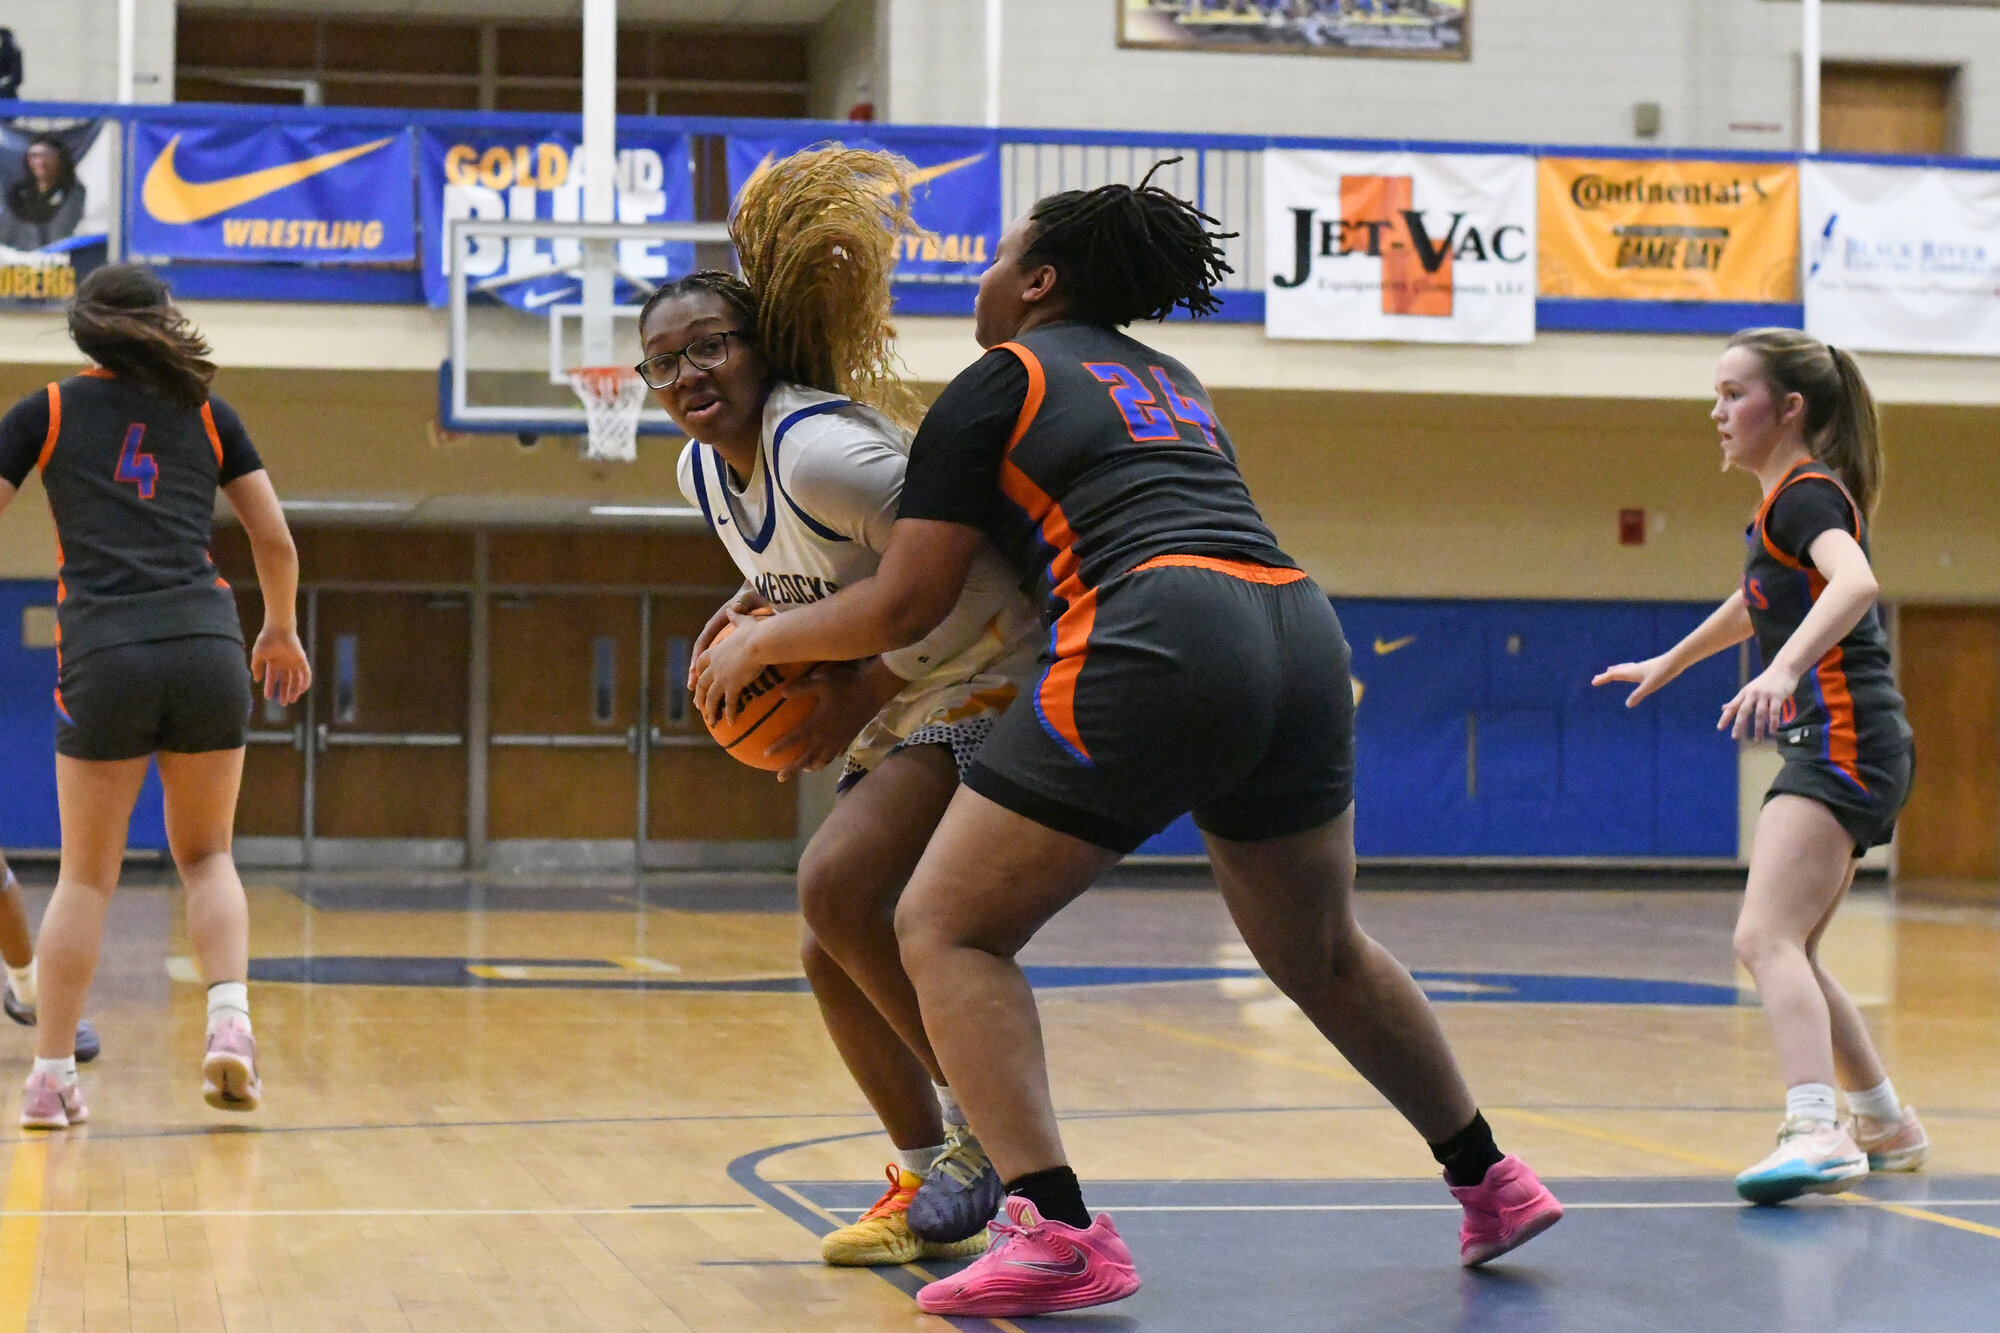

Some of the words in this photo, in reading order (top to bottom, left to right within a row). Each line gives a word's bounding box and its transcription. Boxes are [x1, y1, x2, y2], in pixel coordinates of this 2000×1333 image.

[445, 143, 568, 190] GOLD
[1571, 174, 1741, 211] Continental
[223, 218, 384, 250] WRESTLING
[1081, 361, 1221, 450] 24
[113, 422, 159, 499] 4
